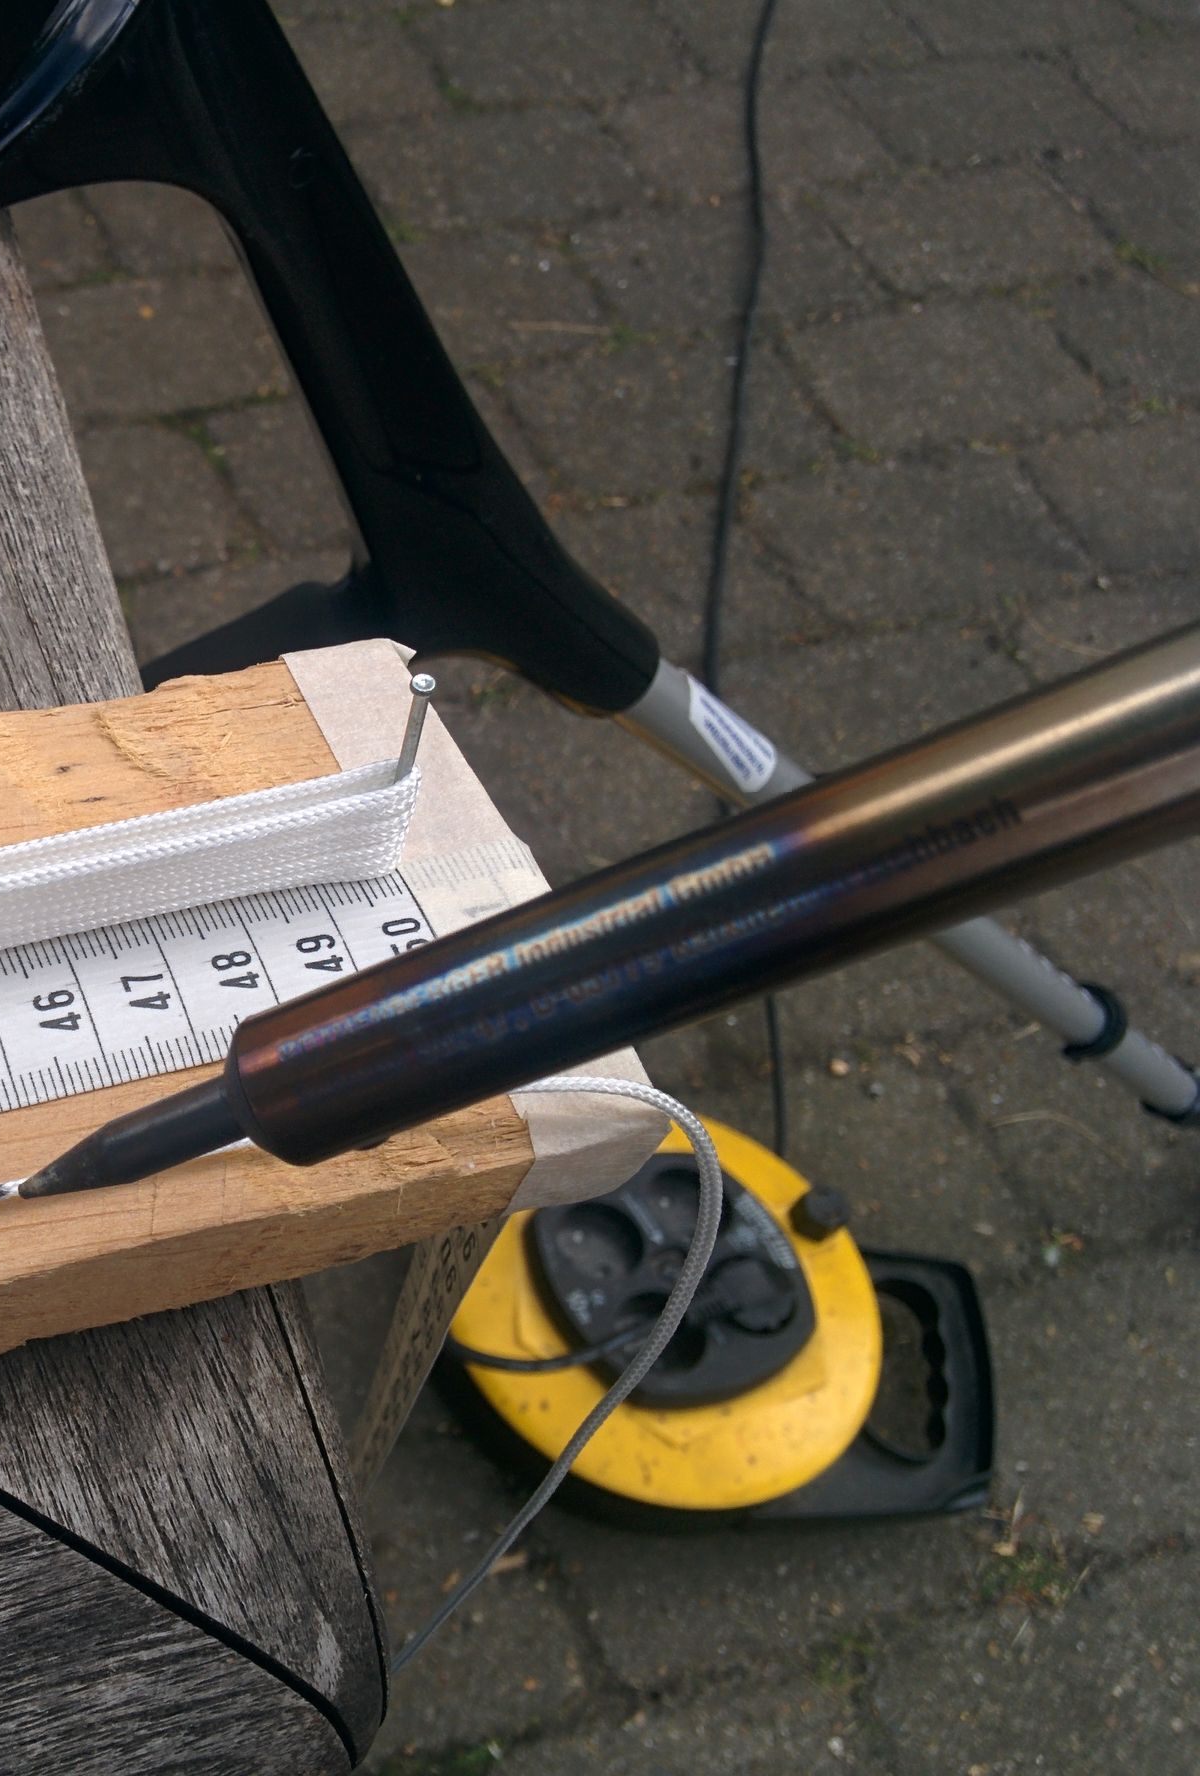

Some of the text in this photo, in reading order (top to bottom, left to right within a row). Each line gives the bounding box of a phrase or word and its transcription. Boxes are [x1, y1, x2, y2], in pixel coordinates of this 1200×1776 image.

[211, 950, 260, 990] 48
[296, 933, 345, 973] 49
[32, 989, 82, 1032] 46
[120, 972, 171, 1011] 47
